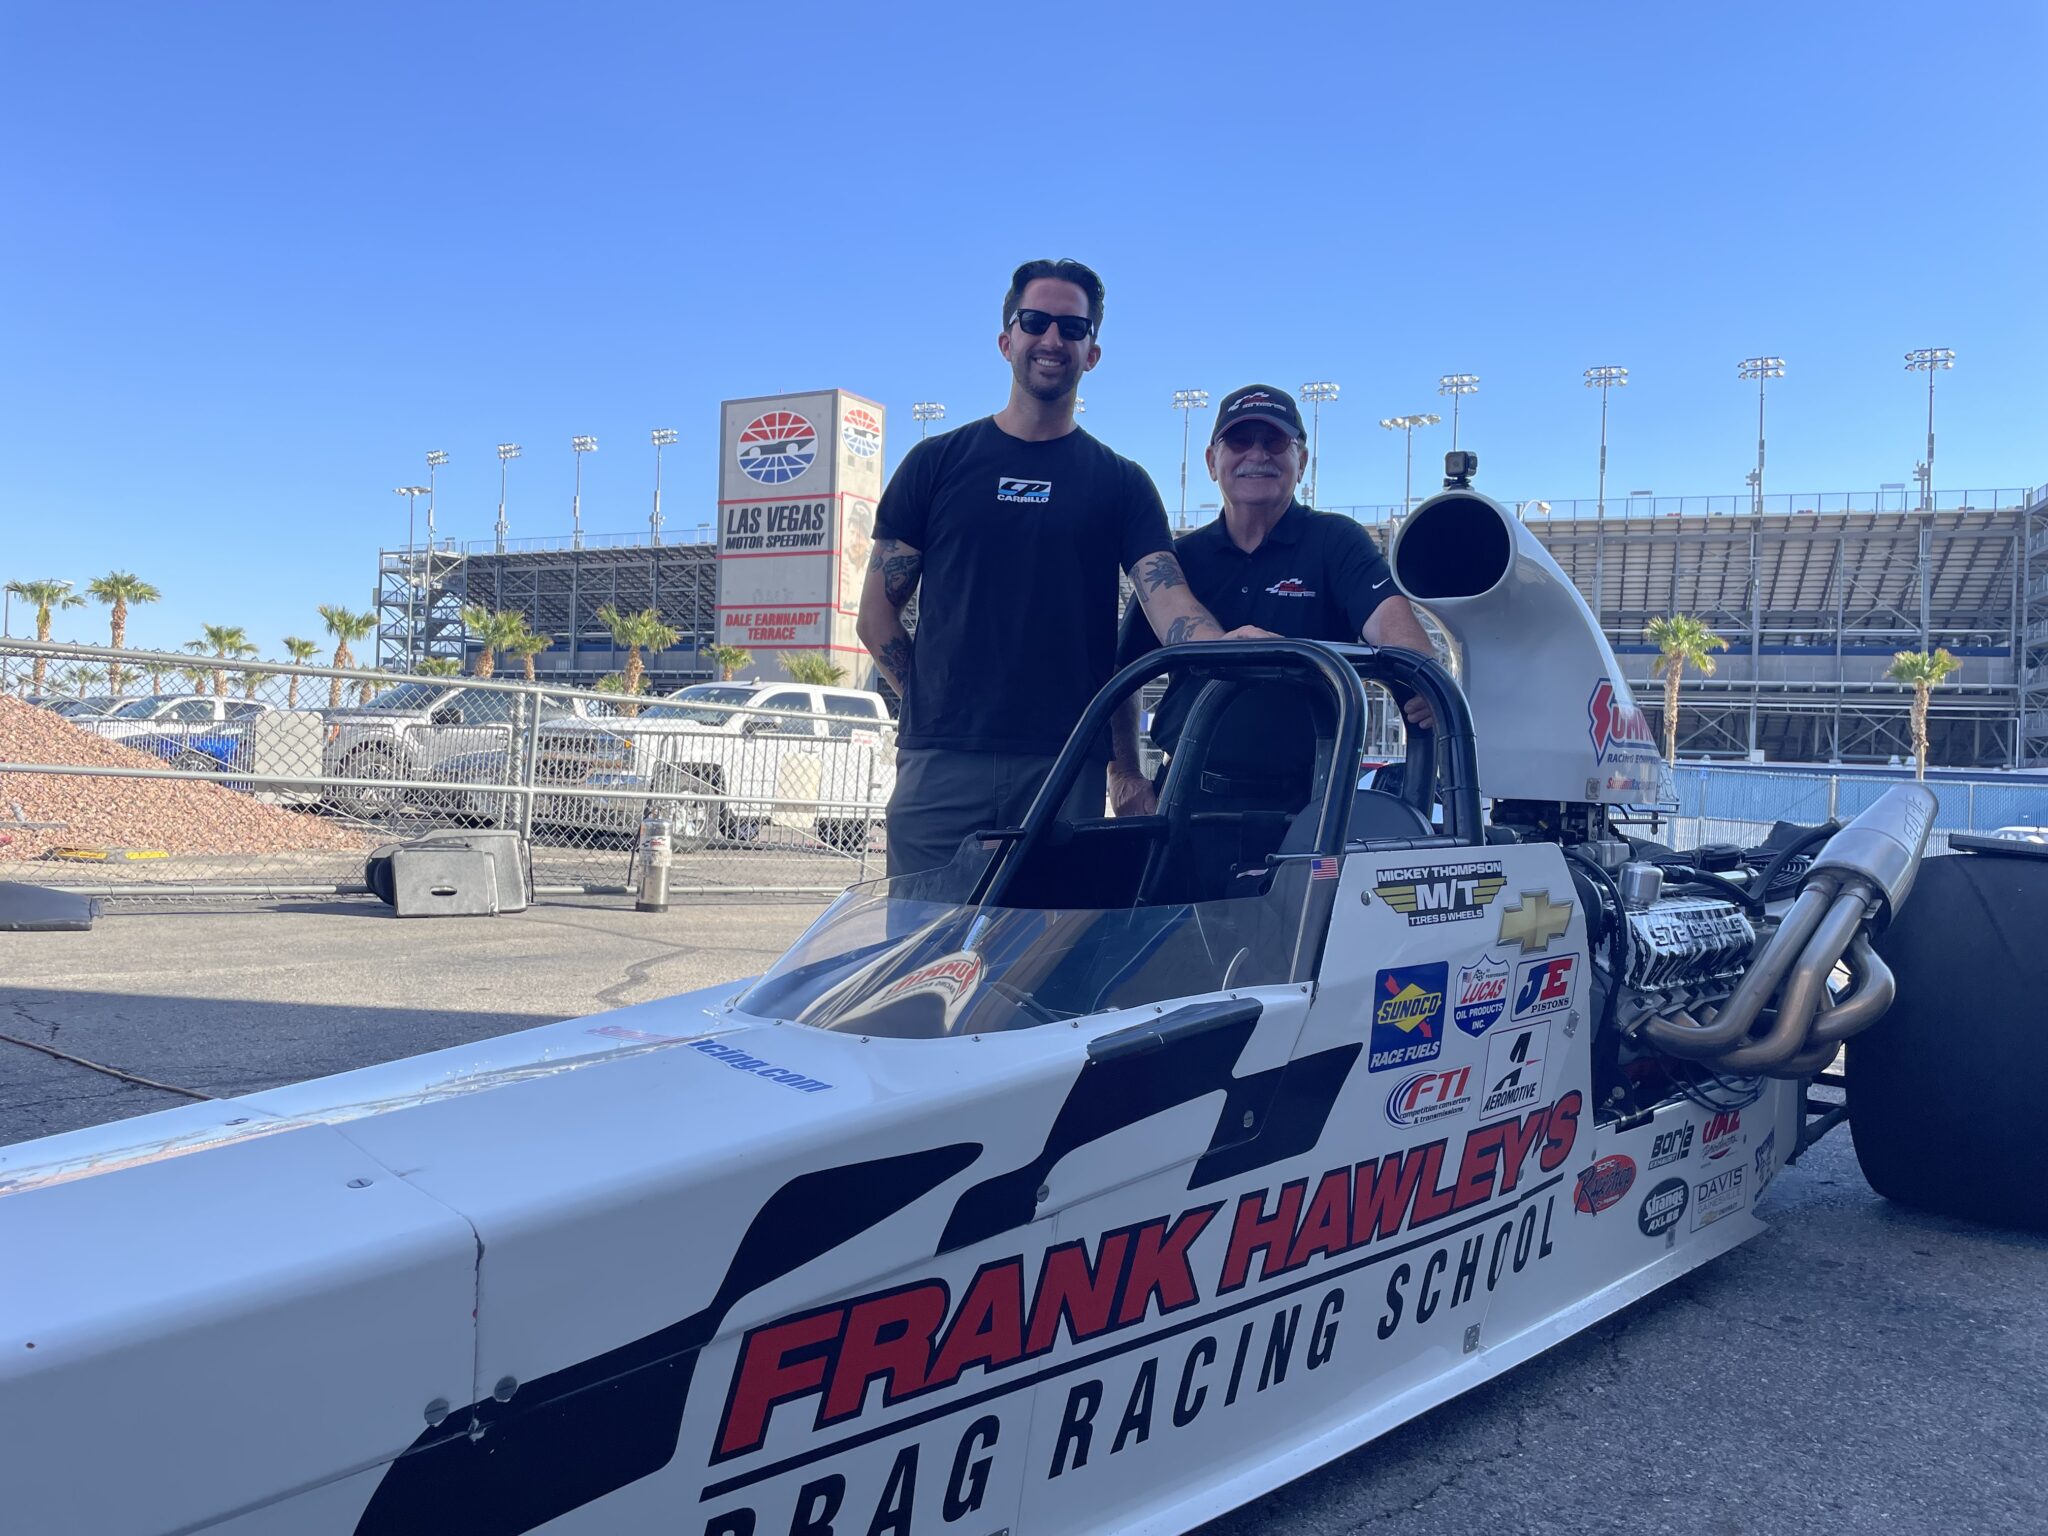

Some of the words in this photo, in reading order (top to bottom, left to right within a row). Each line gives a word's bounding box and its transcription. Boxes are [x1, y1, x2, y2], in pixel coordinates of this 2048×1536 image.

[997, 494, 1050, 503] CARRILLO
[726, 507, 762, 535] LAS
[767, 503, 825, 533] VEGAS
[725, 535, 764, 550] MOTOR
[765, 532, 826, 548] SPEEDWAY
[725, 613, 753, 627] DALE
[754, 612, 820, 627] EARNHARDT
[748, 627, 796, 641] TERRACE
[1377, 867, 1430, 882] MICKEY
[1431, 862, 1501, 878] THOMPSON
[1409, 913, 1440, 925] TIRES
[1440, 913, 1447, 922] &
[1447, 909, 1483, 921] WHEELS
[1460, 978, 1506, 1005] LUCAS
[1515, 958, 1573, 1016] JE
[1379, 995, 1440, 1022] SUNOCO
[1456, 1010, 1467, 1020] OIL
[1469, 1002, 1504, 1018] PRODUCTS
[1531, 997, 1569, 1013] PISTONS
[1472, 1020, 1486, 1030] INC.
[1370, 1048, 1406, 1068] RACE
[1404, 1041, 1440, 1062] FUELS
[1404, 1066, 1472, 1111] FTI
[1482, 1082, 1537, 1112] AEROMOTIVE
[1400, 1104, 1438, 1120] competition
[1438, 1096, 1471, 1109] converters
[1413, 1116, 1419, 1124] &
[1420, 1106, 1464, 1124] transmissions
[1698, 1168, 1743, 1202] DAVIS
[708, 1199, 1226, 1468] FRANK
[1215, 1089, 1582, 1296] HAWLEY'S
[703, 1414, 1001, 1536] RAG
[1048, 1286, 1345, 1480] RACING
[1377, 1195, 1557, 1340] SCHOOL
